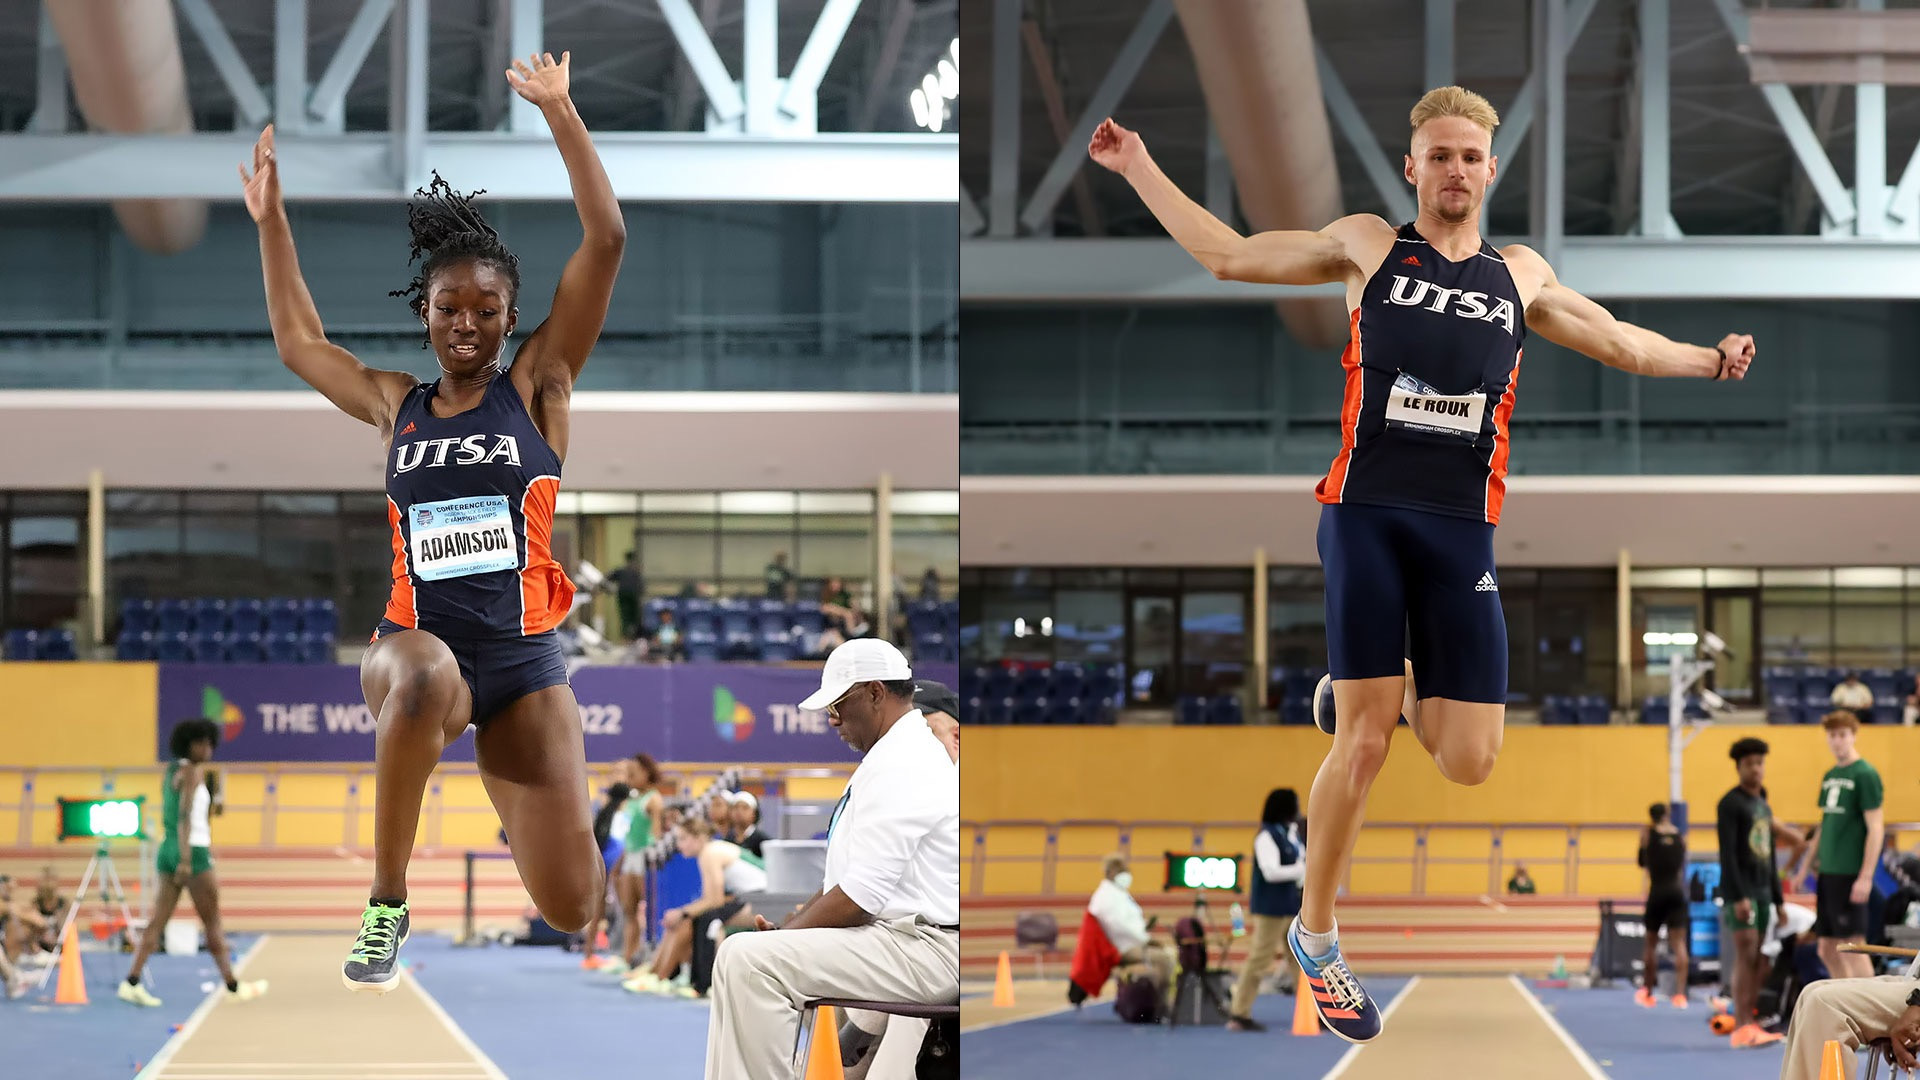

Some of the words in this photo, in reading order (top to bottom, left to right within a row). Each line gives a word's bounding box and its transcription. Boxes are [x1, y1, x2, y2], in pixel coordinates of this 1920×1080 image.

[1389, 274, 1515, 336] UTSA
[1403, 396, 1422, 410] LE
[1424, 398, 1471, 418] ROUX
[1404, 422, 1434, 431] BIRMINGHAM
[1434, 426, 1462, 436] CROSSPLEX
[397, 434, 522, 473] UTSA
[436, 501, 485, 512] CONFERENCE
[421, 527, 508, 562] ADAMSON
[436, 566, 469, 576] BIRMINGHAM
[469, 562, 500, 571] CROSSPLEX
[257, 703, 319, 733] THE
[322, 703, 377, 733] WO
[767, 703, 828, 734] THE
